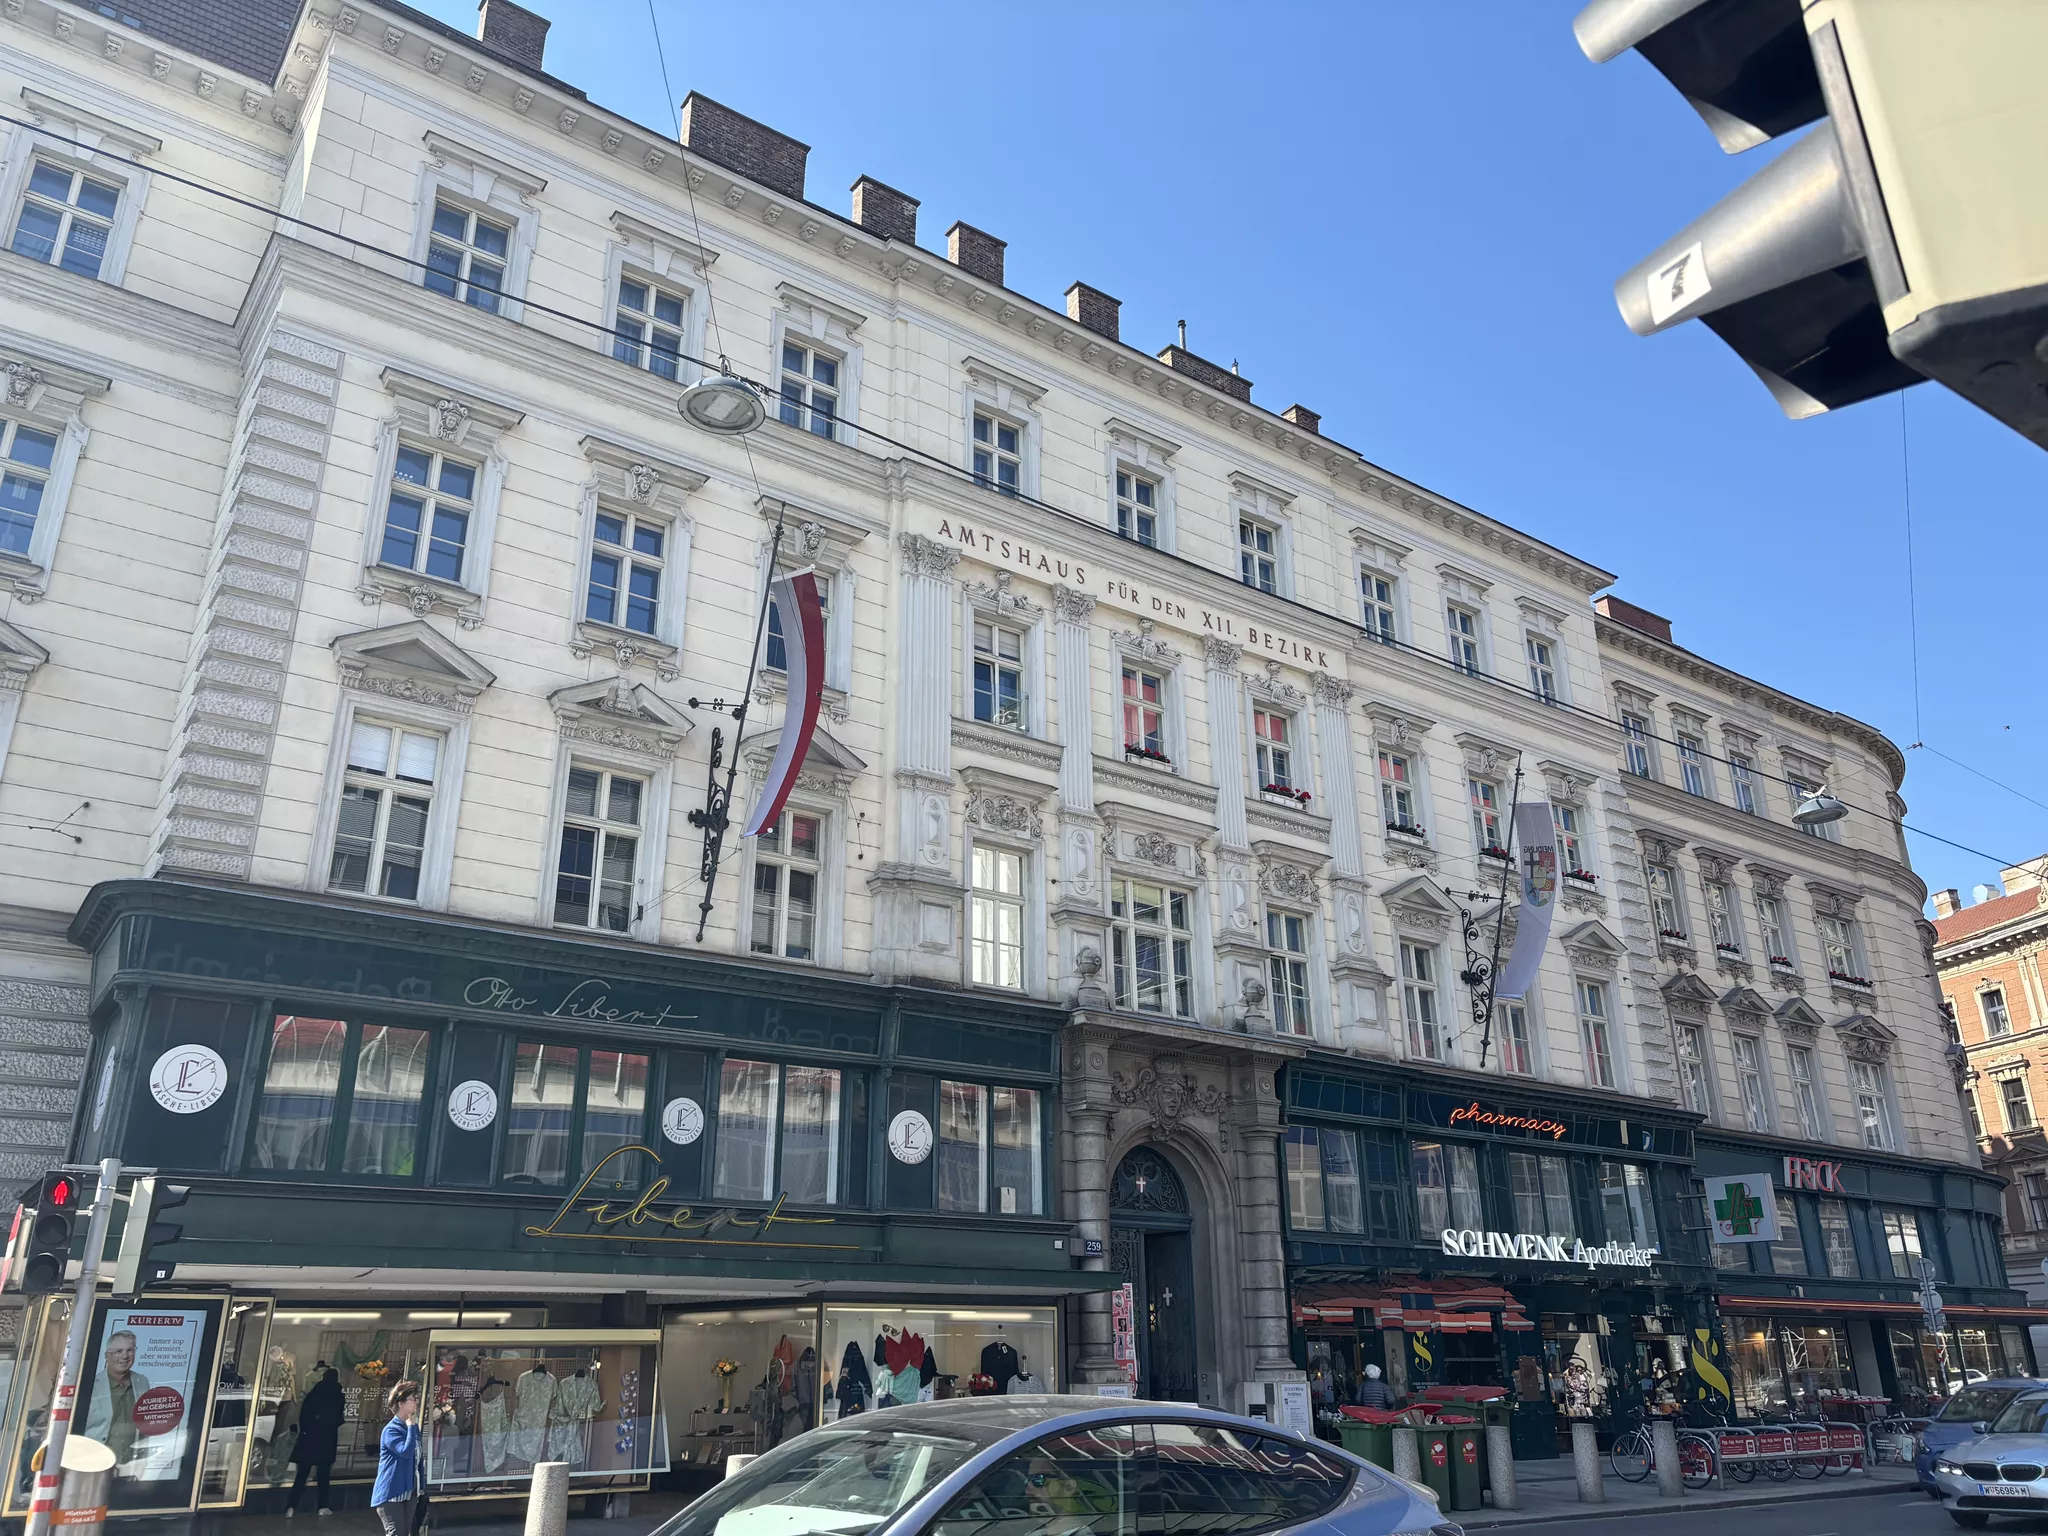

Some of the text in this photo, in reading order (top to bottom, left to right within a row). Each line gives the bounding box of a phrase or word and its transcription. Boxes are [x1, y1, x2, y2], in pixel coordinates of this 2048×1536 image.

[937, 519, 1330, 668] AMTSHAUS FÜR DEN XII. BEZIRK
[543, 978, 699, 1026] Libert
[190, 1087, 222, 1110] LIBERT
[1448, 1102, 1567, 1140] pharmacy
[524, 1145, 860, 1250] Libert
[1086, 1241, 1102, 1252] 259
[1441, 1228, 1653, 1271] SCHWENK Apotheke
[142, 1396, 168, 1405] KURIER
[148, 1402, 181, 1411] GEBHART
